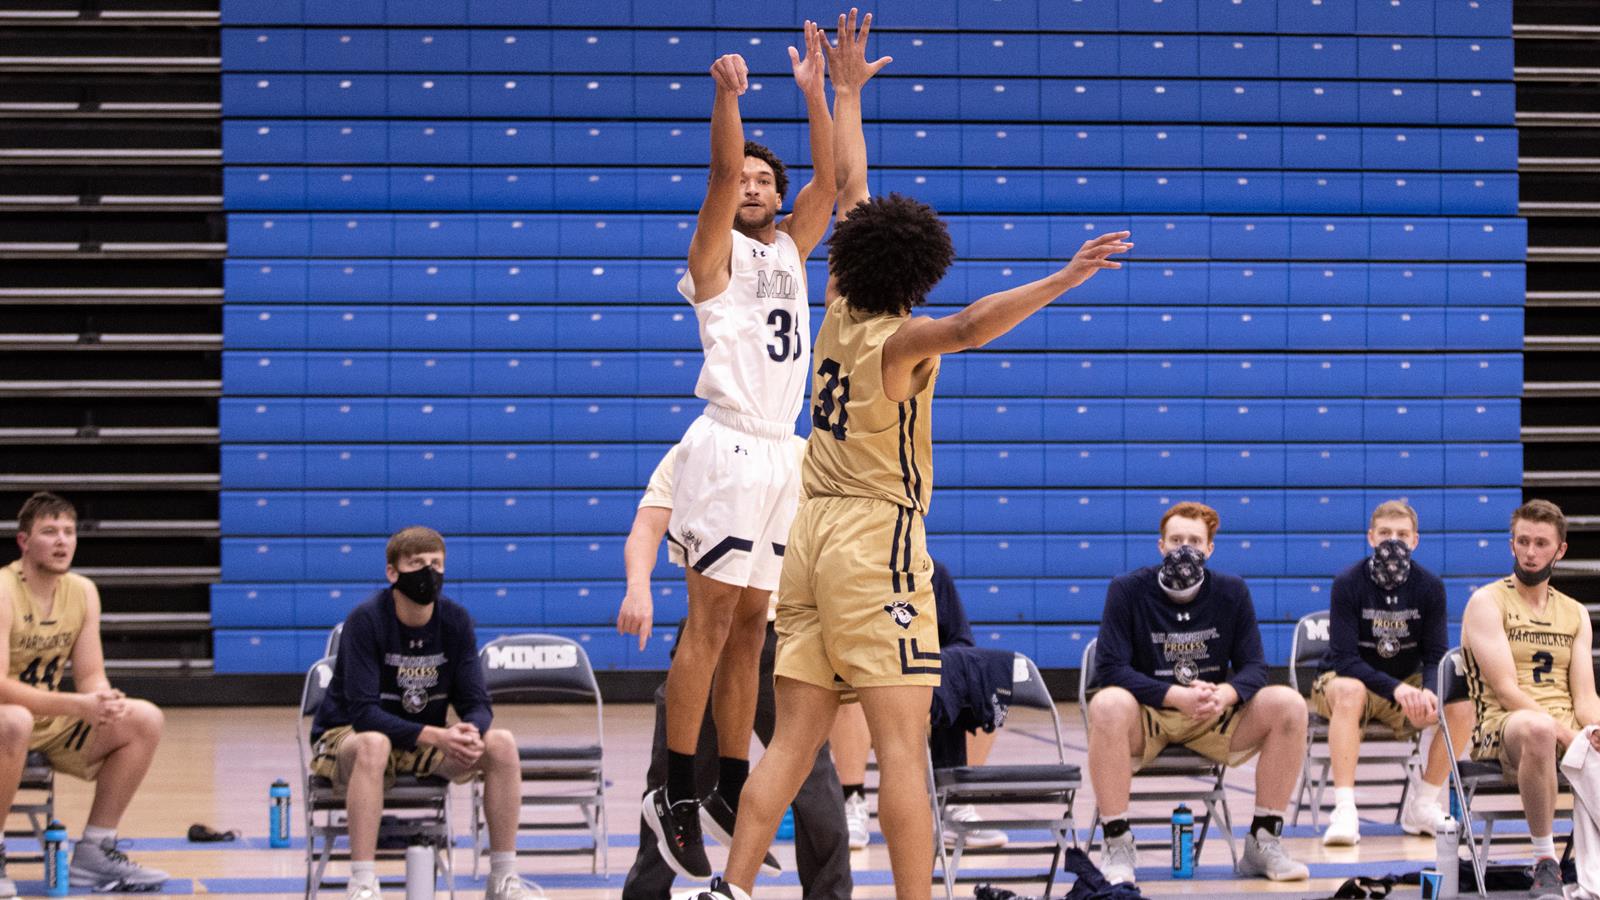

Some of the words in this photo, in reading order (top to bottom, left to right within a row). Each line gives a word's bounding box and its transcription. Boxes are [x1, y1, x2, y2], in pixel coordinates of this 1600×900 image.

[813, 358, 850, 441] 31
[1164, 641, 1206, 652] PROCESS
[19, 656, 60, 691] 44
[1532, 651, 1555, 684] 2
